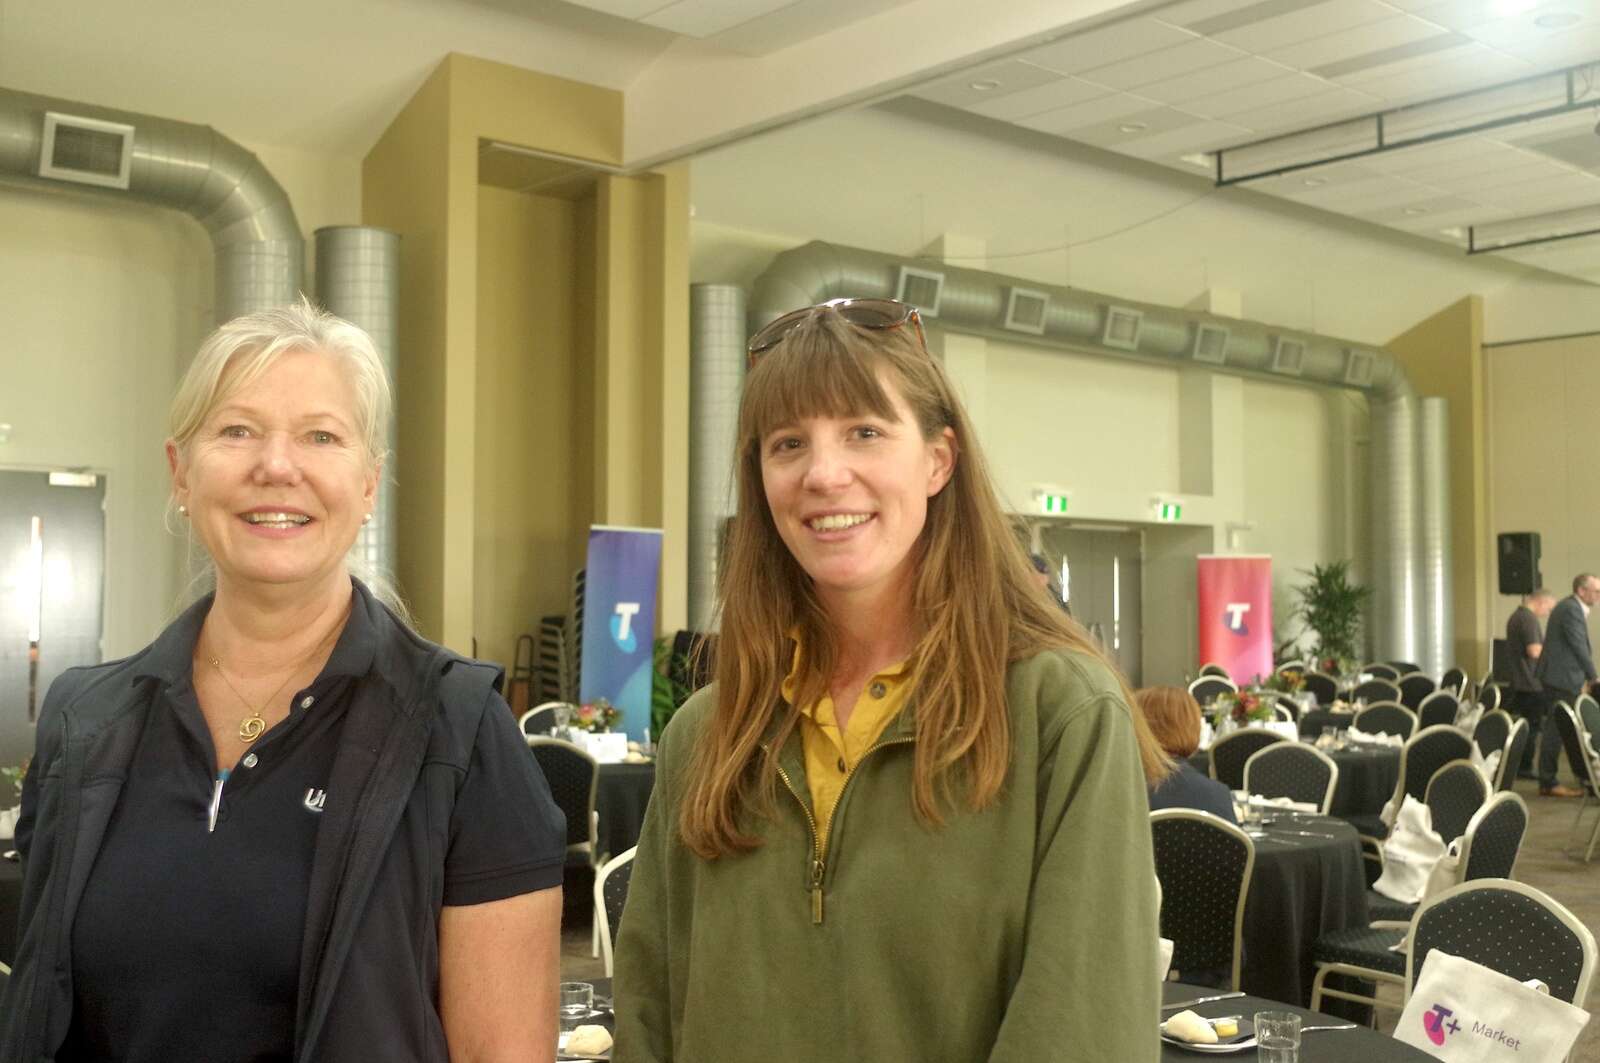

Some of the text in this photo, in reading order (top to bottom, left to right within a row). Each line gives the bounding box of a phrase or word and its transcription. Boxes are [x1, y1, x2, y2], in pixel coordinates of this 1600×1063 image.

[616, 603, 640, 640] T
[1226, 603, 1251, 629] T
[1471, 1021, 1521, 1051] Market
